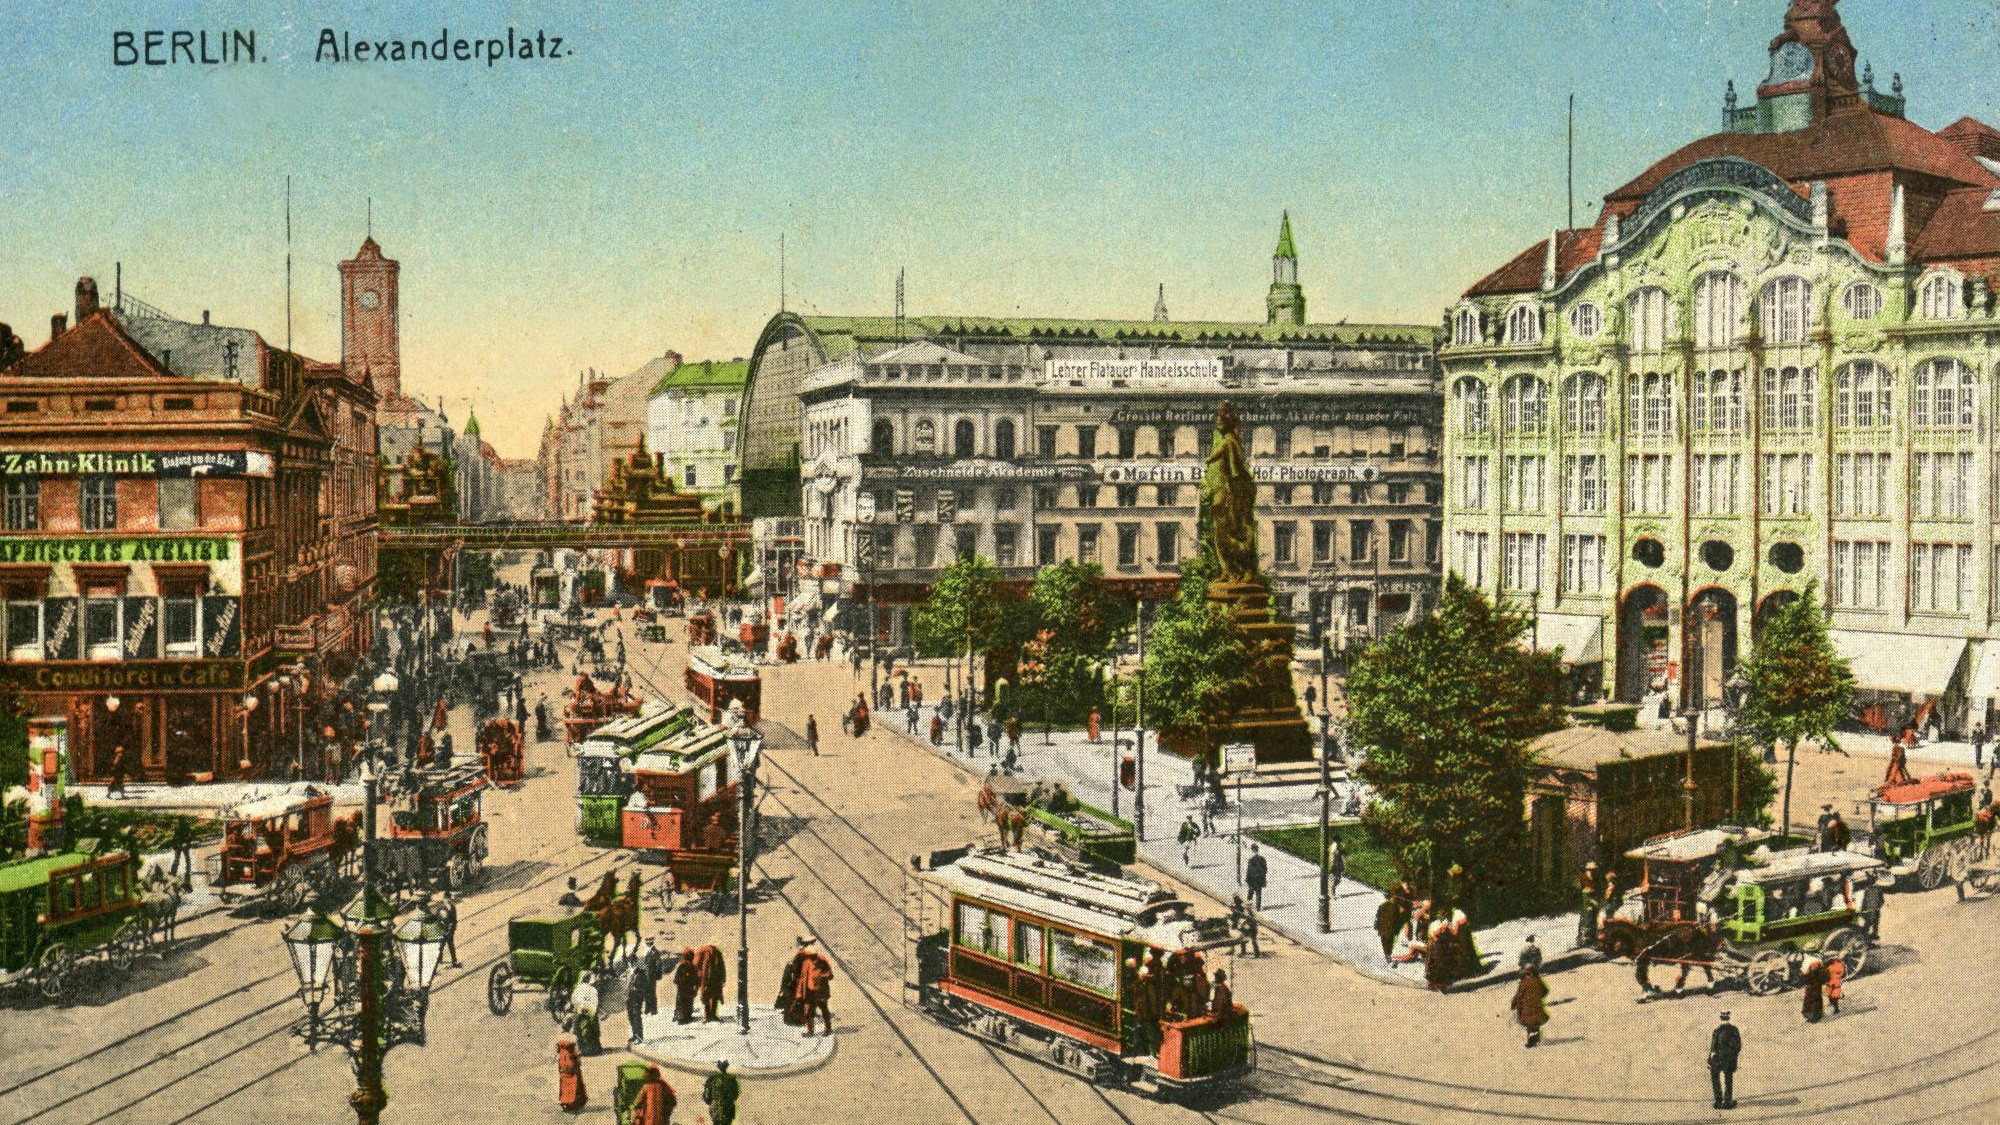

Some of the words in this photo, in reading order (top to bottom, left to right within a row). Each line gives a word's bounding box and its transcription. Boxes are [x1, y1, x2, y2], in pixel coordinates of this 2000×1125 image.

[1052, 361, 1087, 378] Lehrer
[1141, 361, 1217, 378] Handelsschule
[902, 464, 983, 478] Zuschneide
[985, 464, 1056, 478] Akademie
[1123, 466, 1185, 481] Martin
